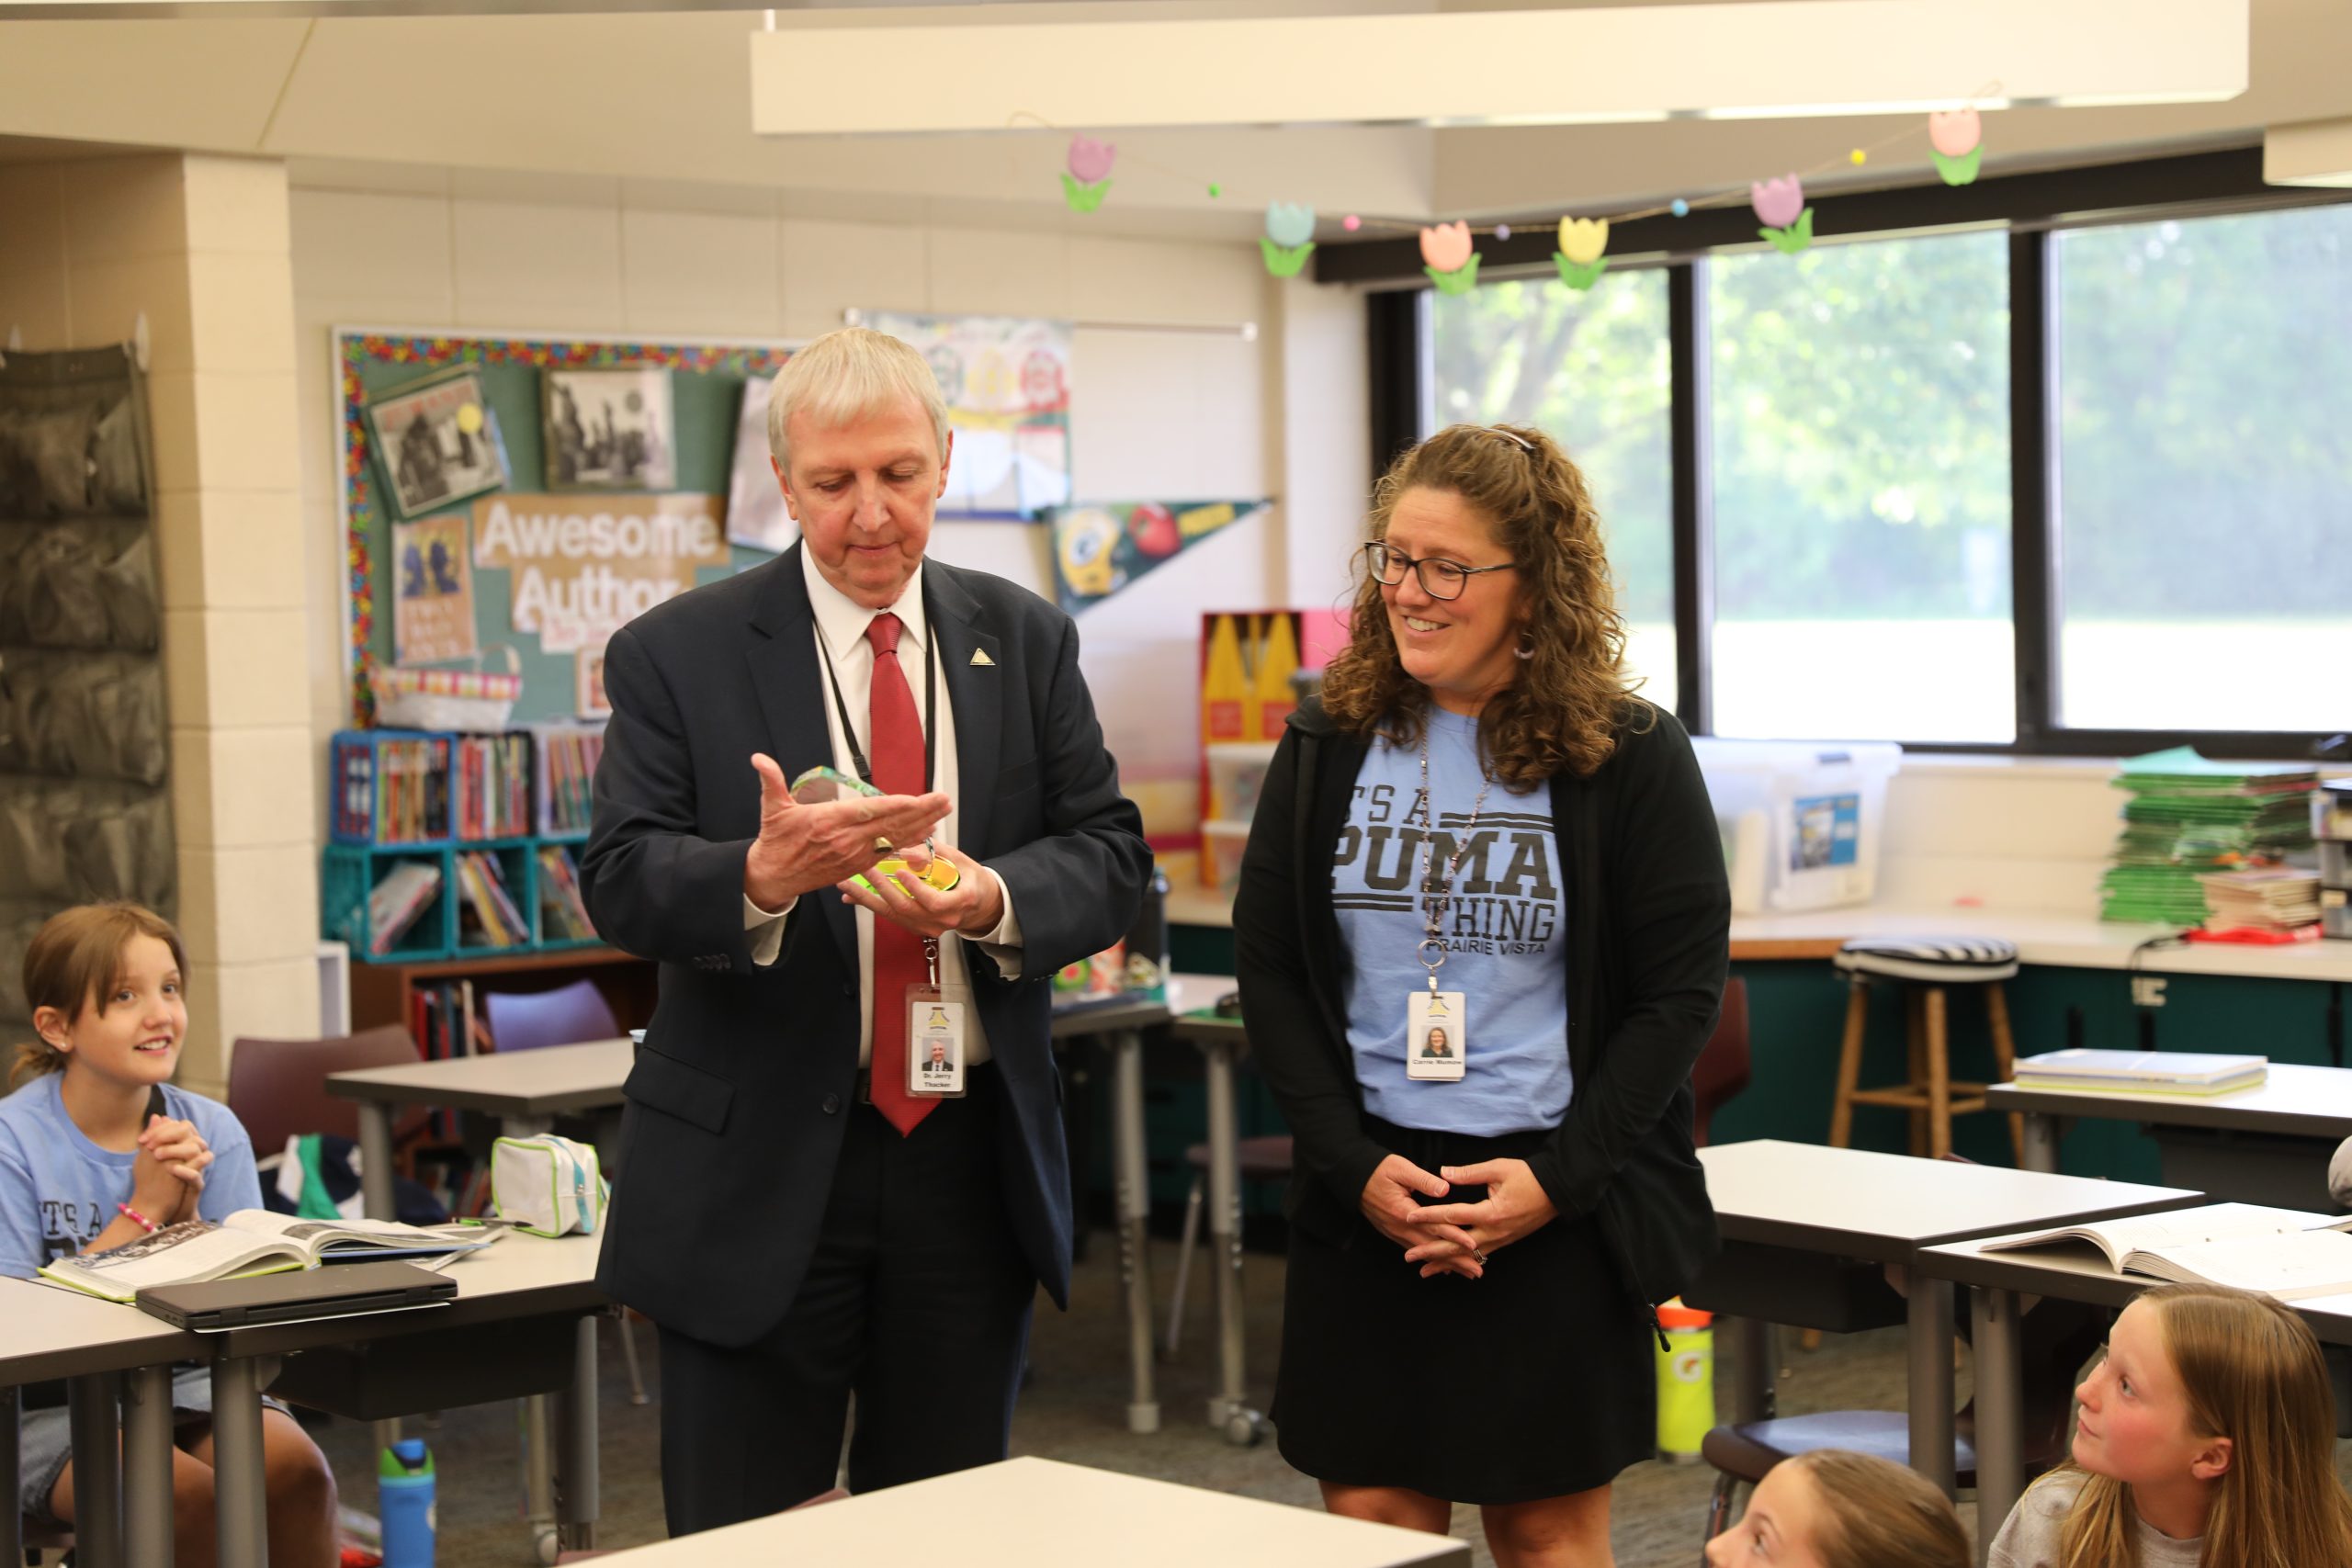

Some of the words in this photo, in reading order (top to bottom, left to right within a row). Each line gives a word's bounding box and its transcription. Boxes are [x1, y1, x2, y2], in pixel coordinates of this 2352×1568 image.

[481, 501, 720, 558] Awesome
[1402, 788, 1430, 827] A
[1333, 825, 1557, 901] PUMA
[1421, 897, 1556, 942] THING
[1425, 936, 1493, 955] PRAIRIE
[1499, 942, 1546, 956] VISTA
[87, 1201, 102, 1237] A
